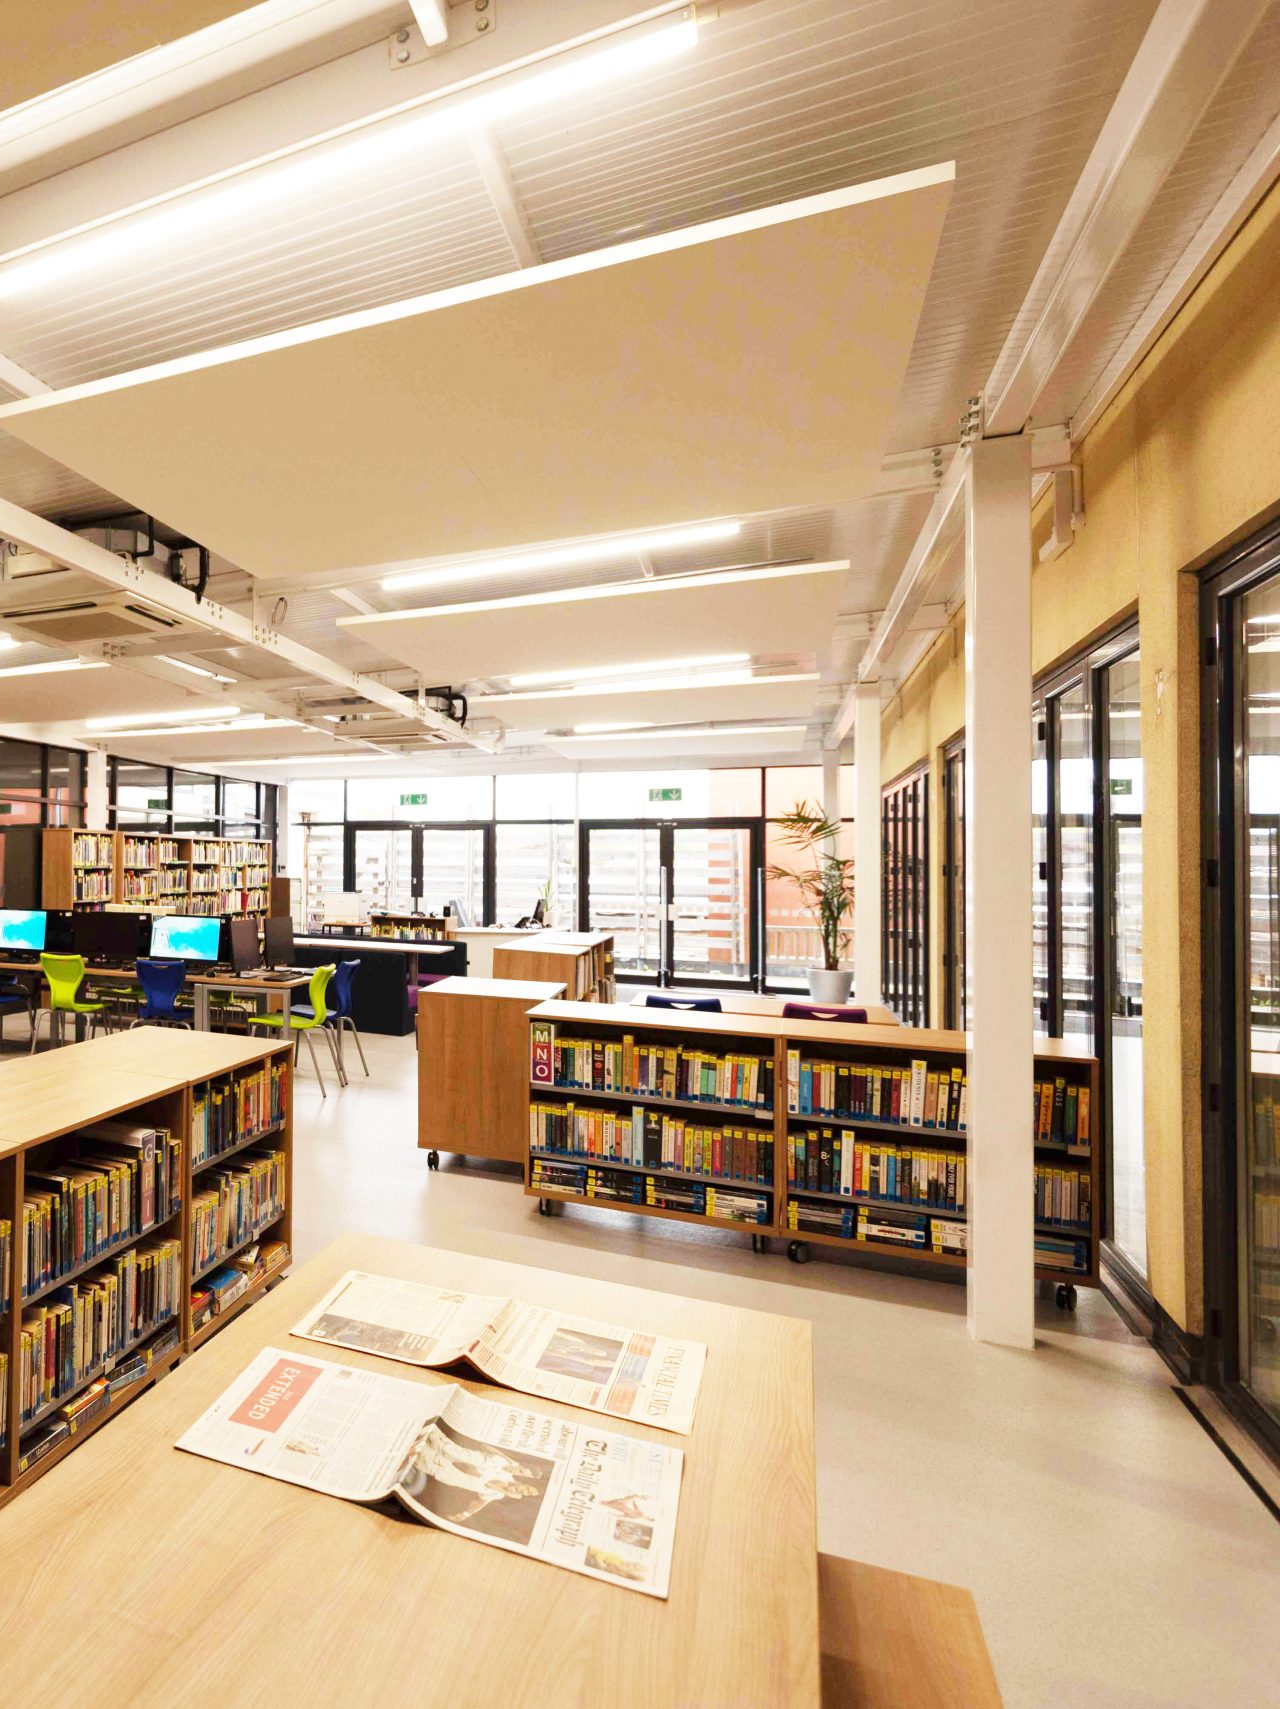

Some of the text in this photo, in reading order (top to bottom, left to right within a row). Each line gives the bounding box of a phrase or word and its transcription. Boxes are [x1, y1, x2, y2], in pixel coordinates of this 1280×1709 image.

[536, 1030, 549, 1043] M
[536, 1048, 548, 1060] N
[535, 1064, 549, 1077] O
[144, 1143, 153, 1162] G
[145, 1170, 154, 1189] H
[655, 1345, 686, 1390] FINANCIAL
[248, 1366, 301, 1420] EXTENDED
[646, 1389, 673, 1419] TIMES
[582, 1438, 608, 1460] The
[569, 1459, 603, 1490] Daily
[555, 1489, 596, 1548] Telegraph
